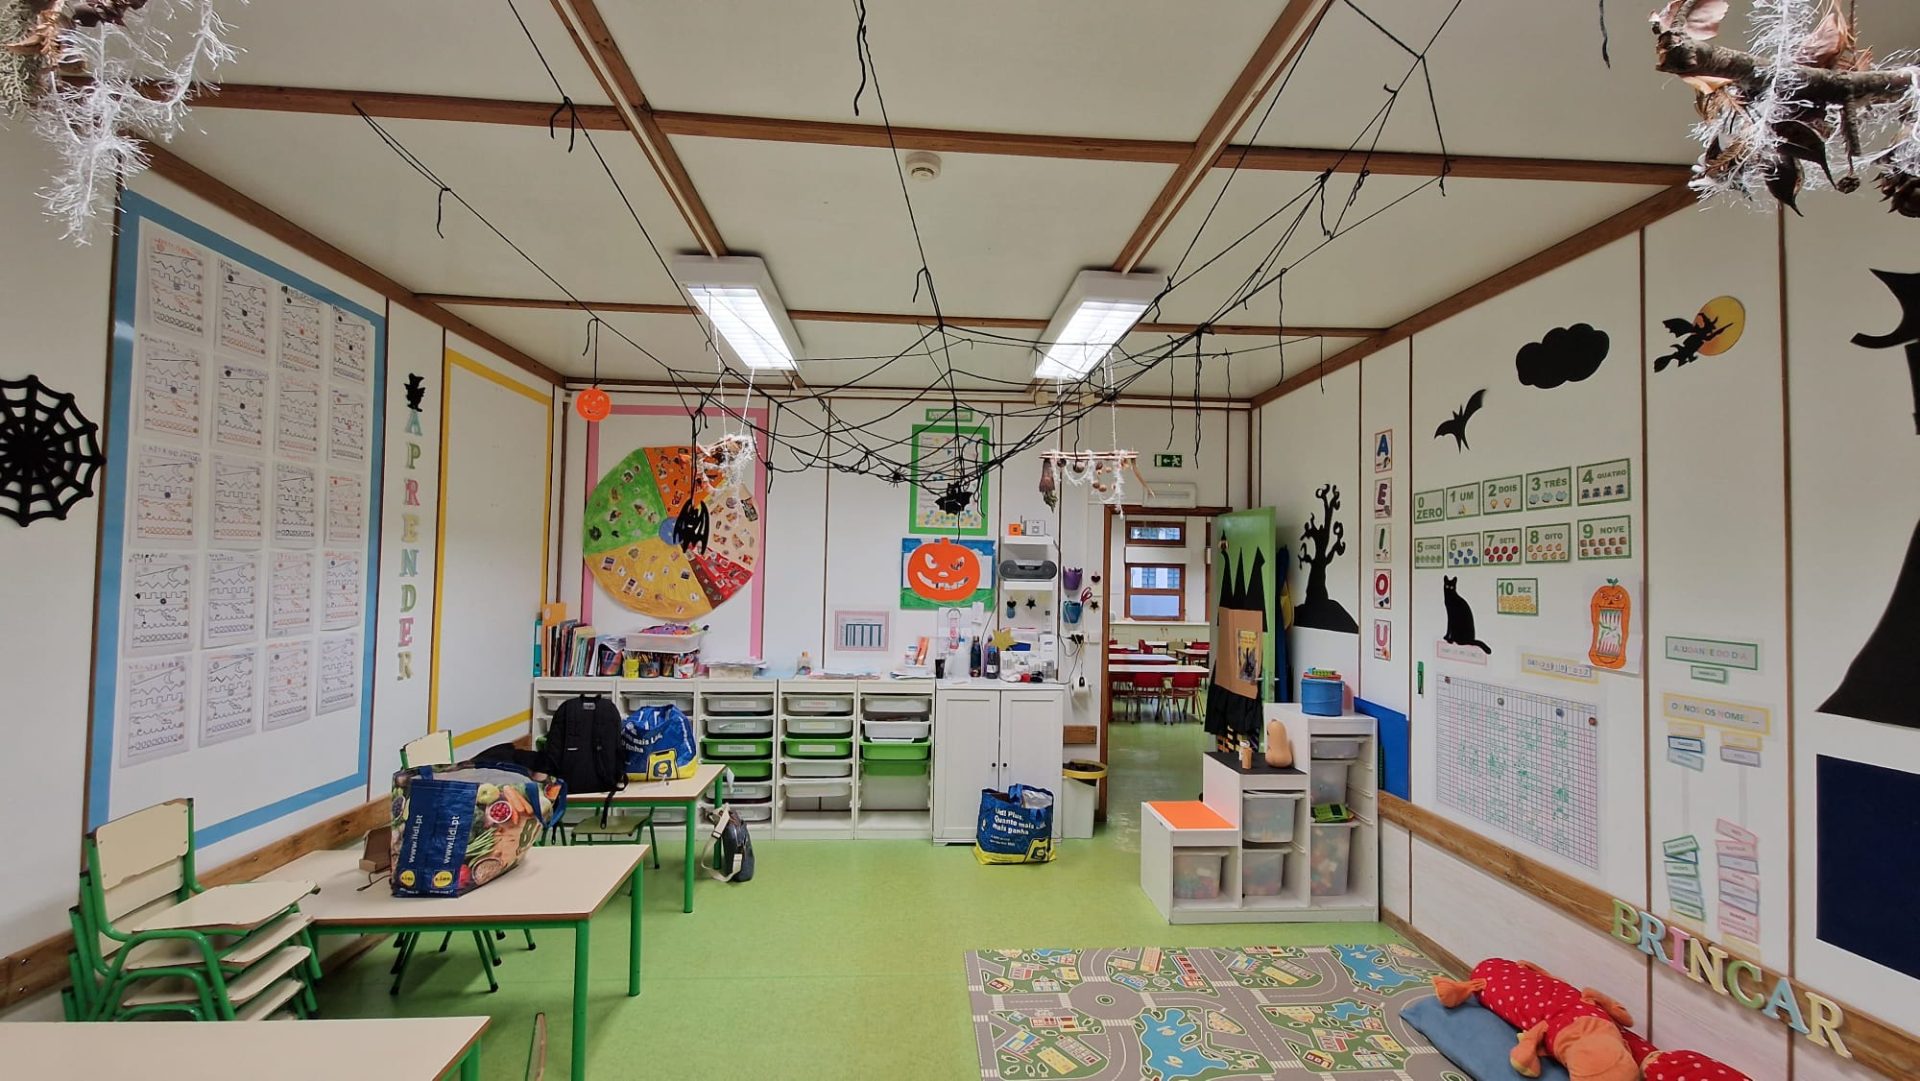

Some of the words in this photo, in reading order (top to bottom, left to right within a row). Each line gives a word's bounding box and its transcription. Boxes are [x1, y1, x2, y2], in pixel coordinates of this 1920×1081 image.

[1377, 434, 1389, 457] A
[1532, 477, 1541, 491] 3
[1582, 469, 1594, 485] 4
[1597, 469, 1627, 480] QUATRO
[1378, 483, 1388, 505] E
[1450, 491, 1456, 502] 1
[1460, 491, 1474, 501] UM
[1488, 484, 1496, 497] 2
[1498, 484, 1517, 494] DOIS
[1418, 497, 1424, 508] 0
[1416, 508, 1443, 520] ZERO
[1379, 527, 1386, 550] I
[1530, 530, 1539, 544] 8
[1544, 532, 1563, 540] OITO
[1583, 523, 1594, 539] 9
[1600, 525, 1625, 534] NOVE
[397, 409, 423, 681] APRENDER
[1417, 541, 1423, 553] 5
[1450, 539, 1456, 551] 6
[1486, 534, 1495, 547] 7
[1375, 573, 1389, 596] O
[1498, 582, 1514, 596] 10
[1375, 624, 1388, 647] U
[443, 815, 460, 864] www.lidl.pt
[1610, 898, 1853, 1059] BRINCAR
